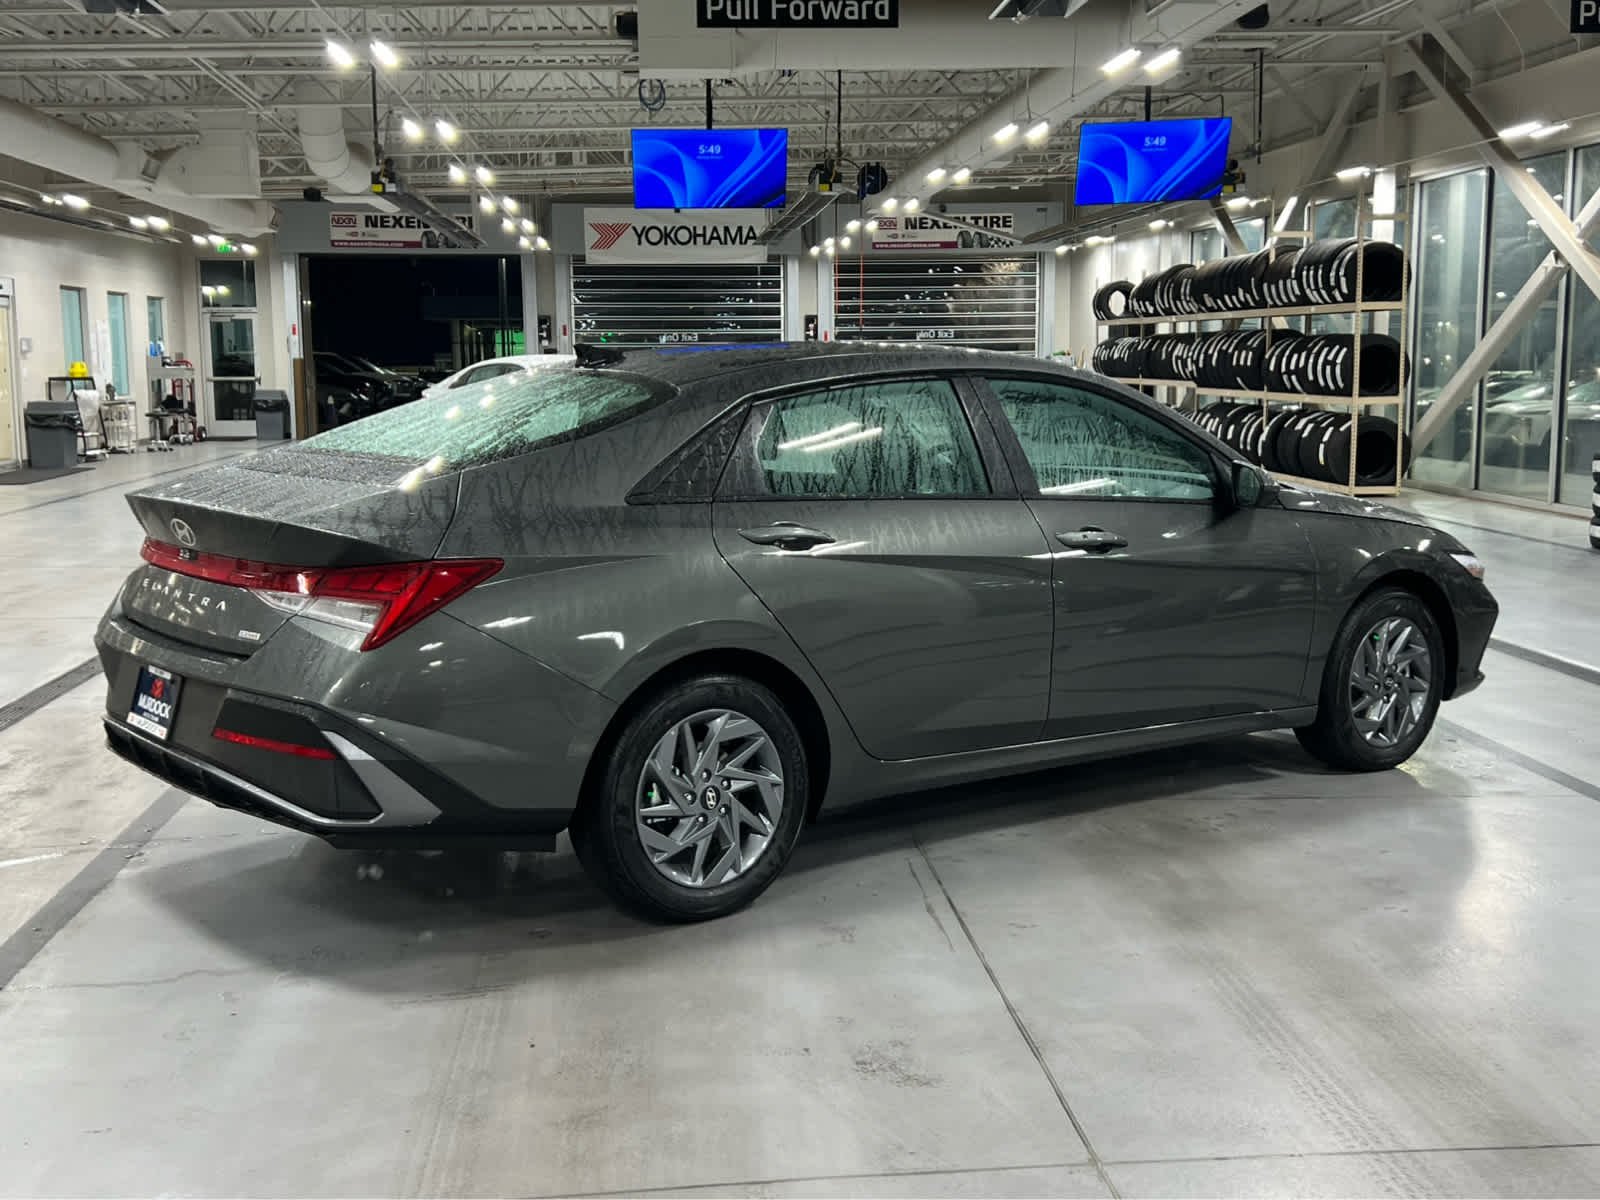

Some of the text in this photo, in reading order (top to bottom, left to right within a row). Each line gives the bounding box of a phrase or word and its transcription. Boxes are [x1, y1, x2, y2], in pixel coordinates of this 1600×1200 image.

[706, 0, 889, 20] Pull Forward
[699, 144, 721, 154] 5:49
[970, 215, 1012, 229] TIRE
[632, 225, 757, 246] YOKOHAMA
